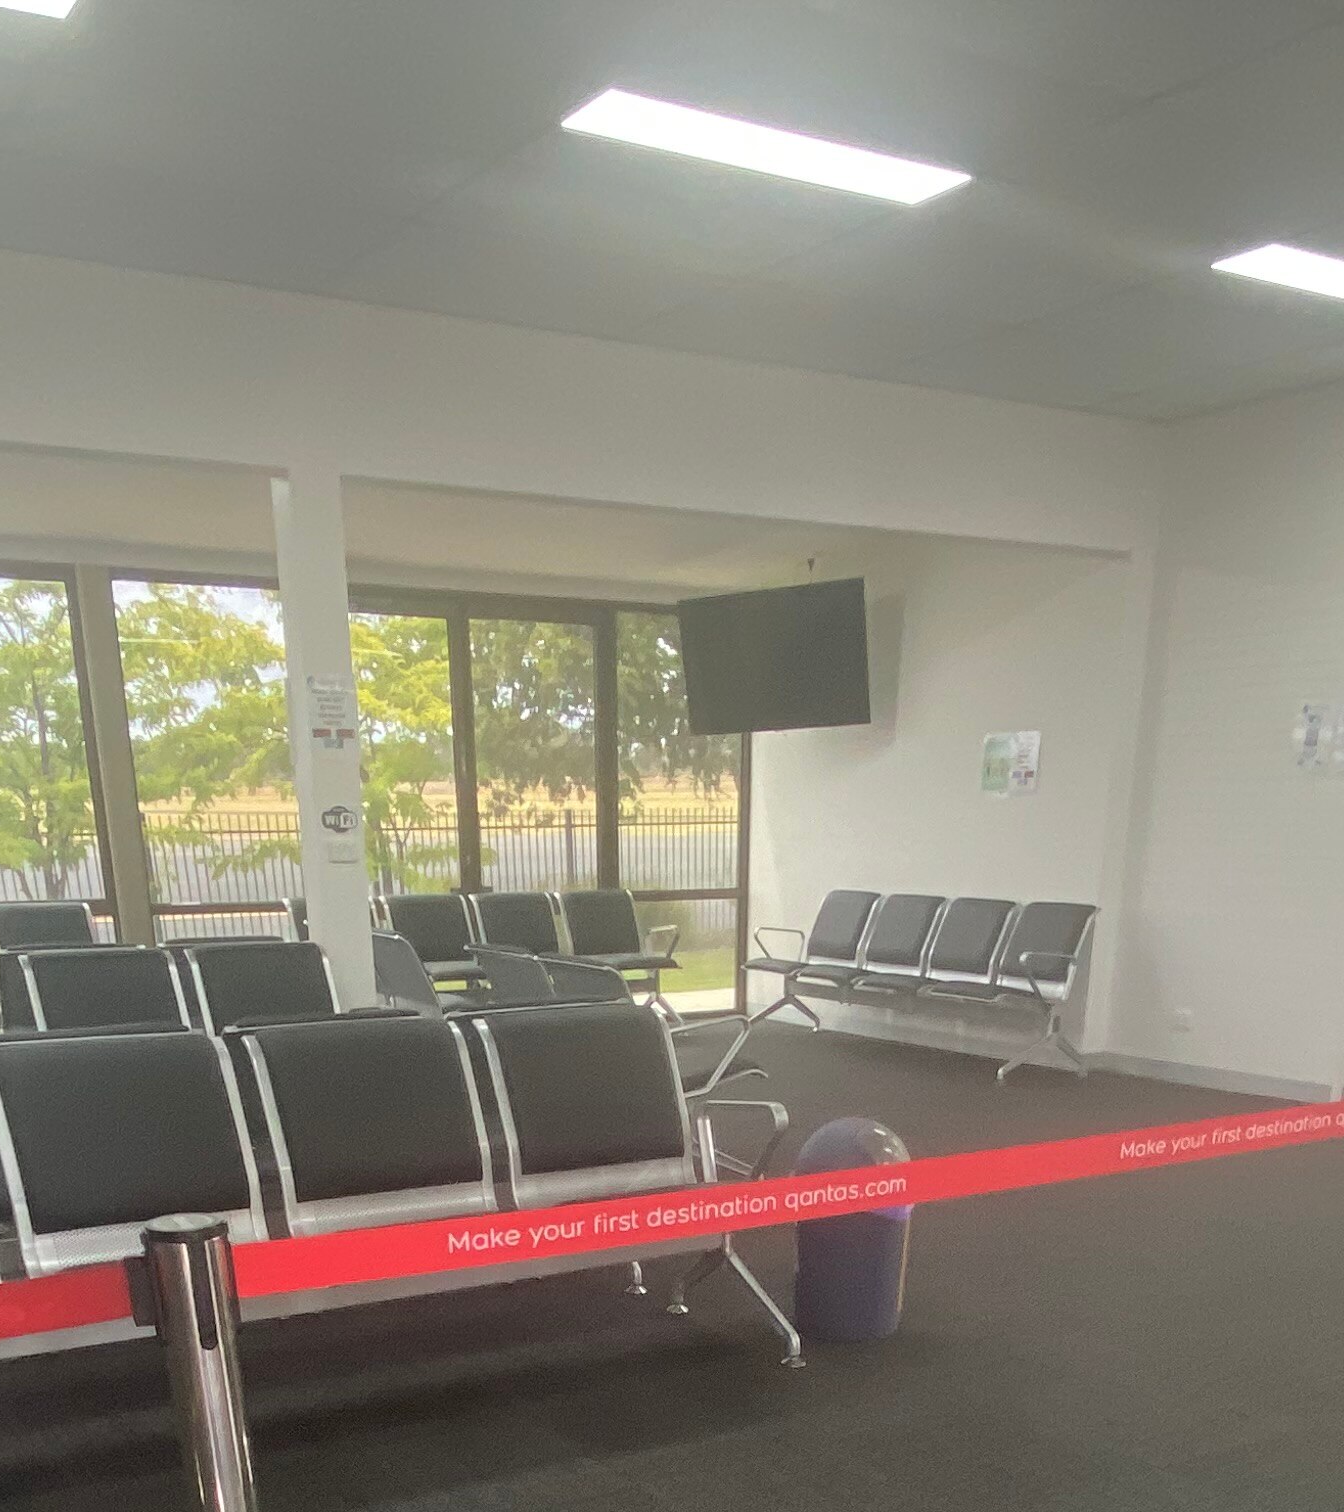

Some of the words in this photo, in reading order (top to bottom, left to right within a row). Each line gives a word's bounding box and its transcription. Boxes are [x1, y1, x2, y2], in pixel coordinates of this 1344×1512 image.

[1120, 1138, 1166, 1159] Make
[1171, 1133, 1208, 1156] your
[1212, 1125, 1242, 1145] first
[1246, 1112, 1331, 1140] destination
[448, 1227, 521, 1253] Make
[529, 1218, 585, 1248] your
[594, 1209, 638, 1234] first
[647, 1194, 777, 1228] destination
[784, 1177, 907, 1212] qantas.com
